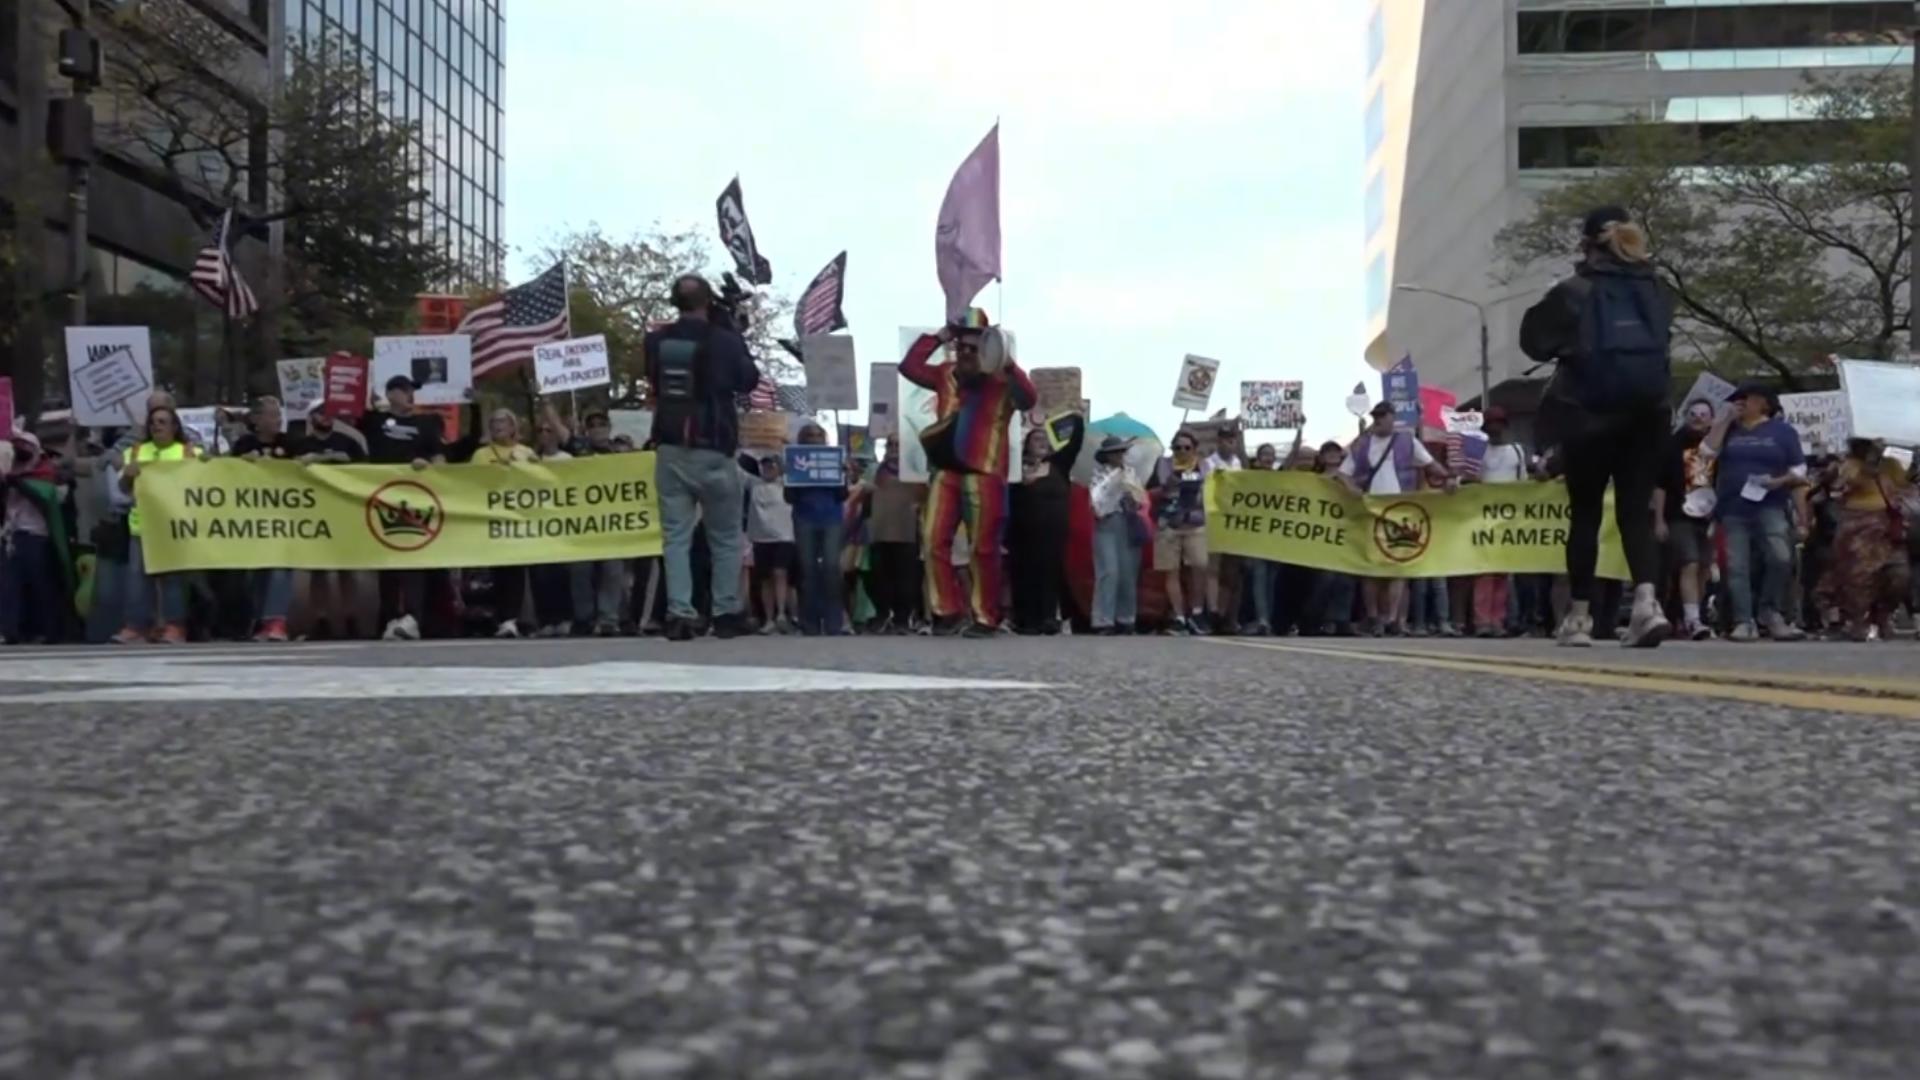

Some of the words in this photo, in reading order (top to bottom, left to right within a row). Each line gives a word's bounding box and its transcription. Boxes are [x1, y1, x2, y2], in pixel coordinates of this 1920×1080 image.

[185, 487, 226, 507] NO
[236, 488, 316, 508] KINGS
[487, 486, 578, 510] PEOPLE
[584, 481, 648, 505] OVER
[1231, 491, 1310, 514] POWER
[1317, 499, 1345, 520] TO
[1482, 503, 1516, 520] NO
[1525, 503, 1571, 520] KIN
[170, 519, 198, 539] IN
[207, 519, 332, 539] AMERICA
[488, 511, 650, 539] BILLIONAIRES
[1223, 513, 1263, 533] THE
[1268, 518, 1346, 546] PEOPLE
[1471, 528, 1495, 546] IN
[1501, 528, 1567, 546] AMER
